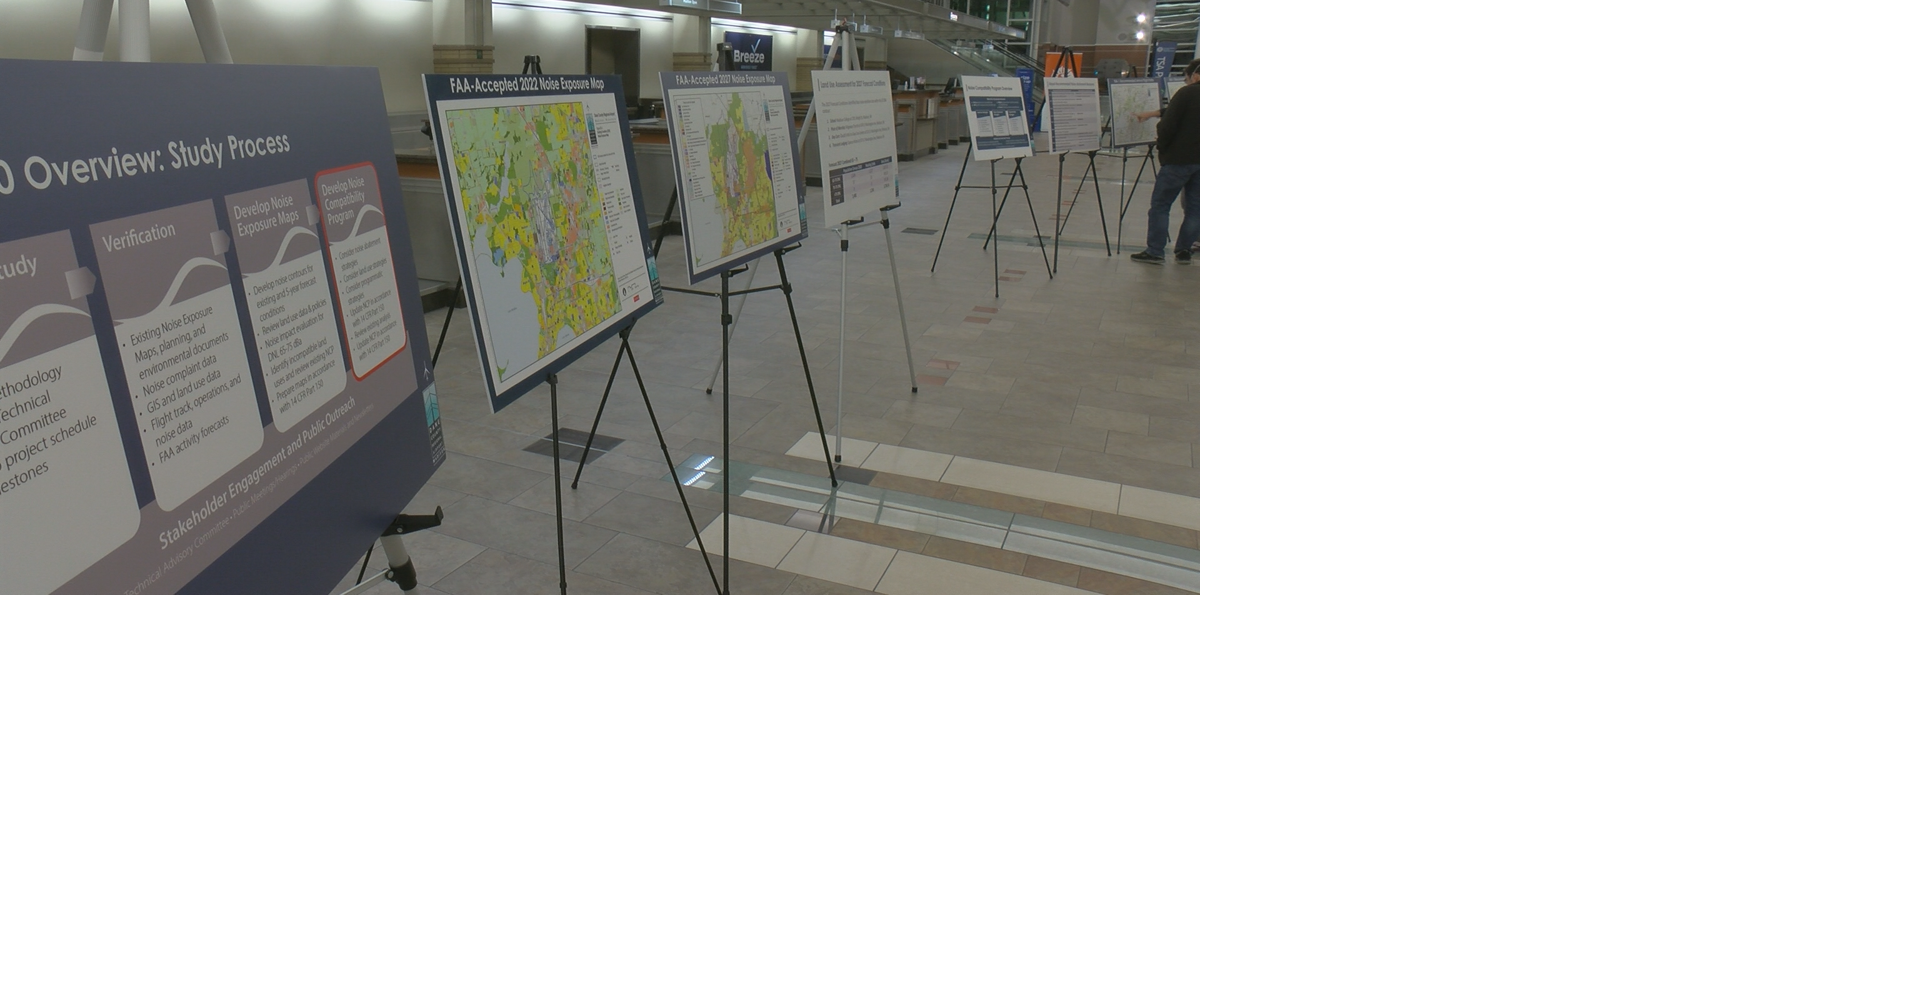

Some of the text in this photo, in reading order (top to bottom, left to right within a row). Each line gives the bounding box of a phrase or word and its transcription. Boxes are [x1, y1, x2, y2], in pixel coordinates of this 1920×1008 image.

[734, 50, 765, 64] Breeze
[1156, 56, 1166, 71] TSA
[450, 77, 605, 95] FAA-Accepted 2022 Noise Exposure Map
[675, 74, 776, 86] FAA-Accepted 2027 Noise Exposure Map
[24, 147, 164, 190] Overview:
[168, 137, 223, 170] Study
[227, 134, 290, 160] Process
[322, 176, 365, 196] Develop Noise
[325, 190, 365, 210] Compatibility
[234, 195, 293, 220] Develop Noise
[237, 211, 299, 237] Exposure Maps
[327, 209, 355, 225] Program
[102, 223, 176, 253] Verification
[253, 282, 275, 296] Develop
[275, 275, 288, 287] noise
[287, 268, 308, 282] contours
[256, 293, 276, 308] existing
[276, 289, 286, 301] and
[299, 277, 317, 290] forecast
[130, 306, 213, 346] Existing Noise Exposure
[259, 304, 286, 322] conditions
[262, 322, 280, 335] Review
[280, 317, 290, 327] land
[290, 313, 299, 322] use
[298, 308, 308, 318] data
[312, 298, 327, 314] policies
[265, 312, 325, 349] Noise impact evaluation for
[134, 323, 206, 363] Maps, planning, and
[139, 331, 229, 380] environmental documents
[268, 351, 279, 362] DNL
[279, 340, 293, 356] 65-75
[270, 337, 328, 375] Identify incompatible land
[142, 354, 217, 397] Noise complaint data
[274, 345, 335, 388] uses and review existing NCP
[276, 359, 336, 401] Prepare maps in accordance
[0, 389, 51, 423] echnical
[146, 369, 221, 413] GIS and land use data
[150, 373, 242, 430] Flight track, operations, and
[280, 378, 324, 414] with 14 CFR Part 150
[0, 407, 67, 445] Committee
[5, 415, 97, 471] project schedule
[155, 419, 193, 447] noise data
[158, 414, 229, 464] FAA activity forecasts
[0, 461, 49, 495] estones
[159, 396, 356, 550] Stakeholder Engagement and Public Outreach
[162, 545, 194, 573] Advisory
[193, 516, 229, 548] Committee
[232, 502, 250, 519] Public
[250, 464, 298, 506] Meetings/Hearings
